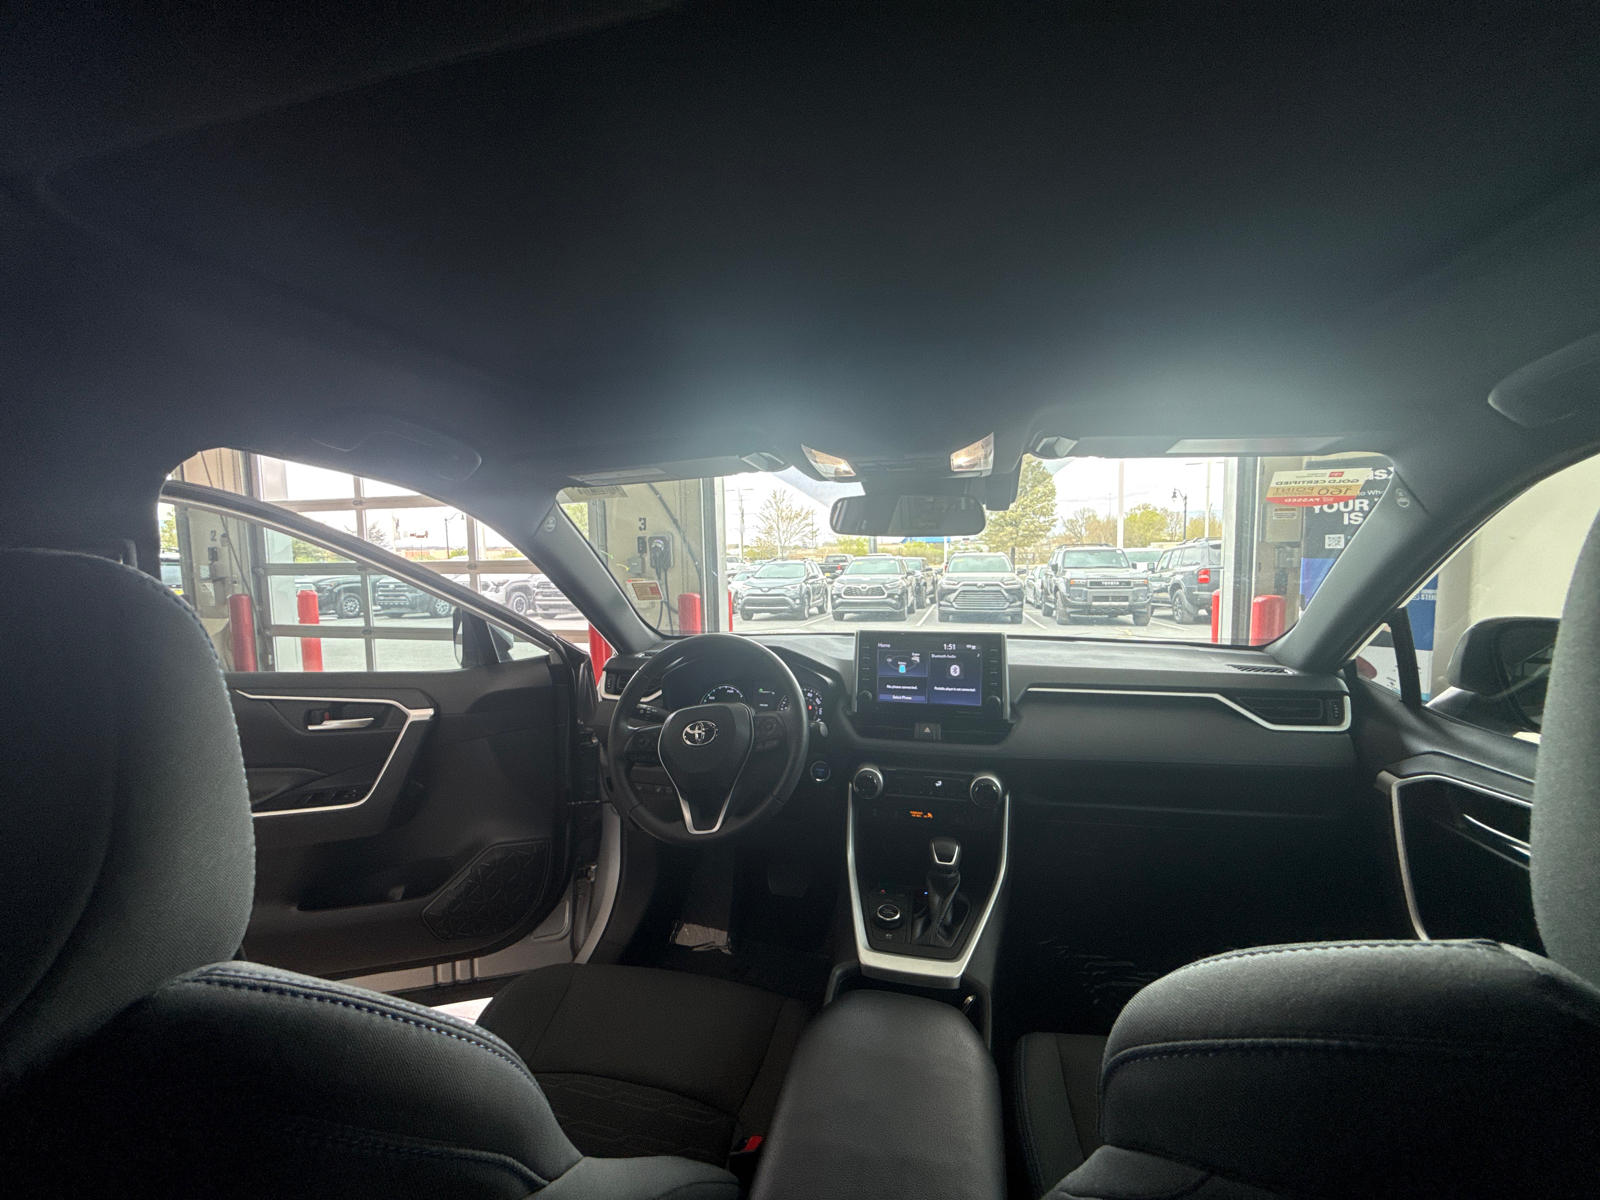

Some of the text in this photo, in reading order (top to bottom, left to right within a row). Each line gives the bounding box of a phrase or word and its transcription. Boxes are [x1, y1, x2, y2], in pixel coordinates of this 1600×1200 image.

[1313, 499, 1369, 514] YOUR
[638, 517, 647, 531] 3
[1343, 511, 1364, 525] IS
[210, 530, 217, 542] 2
